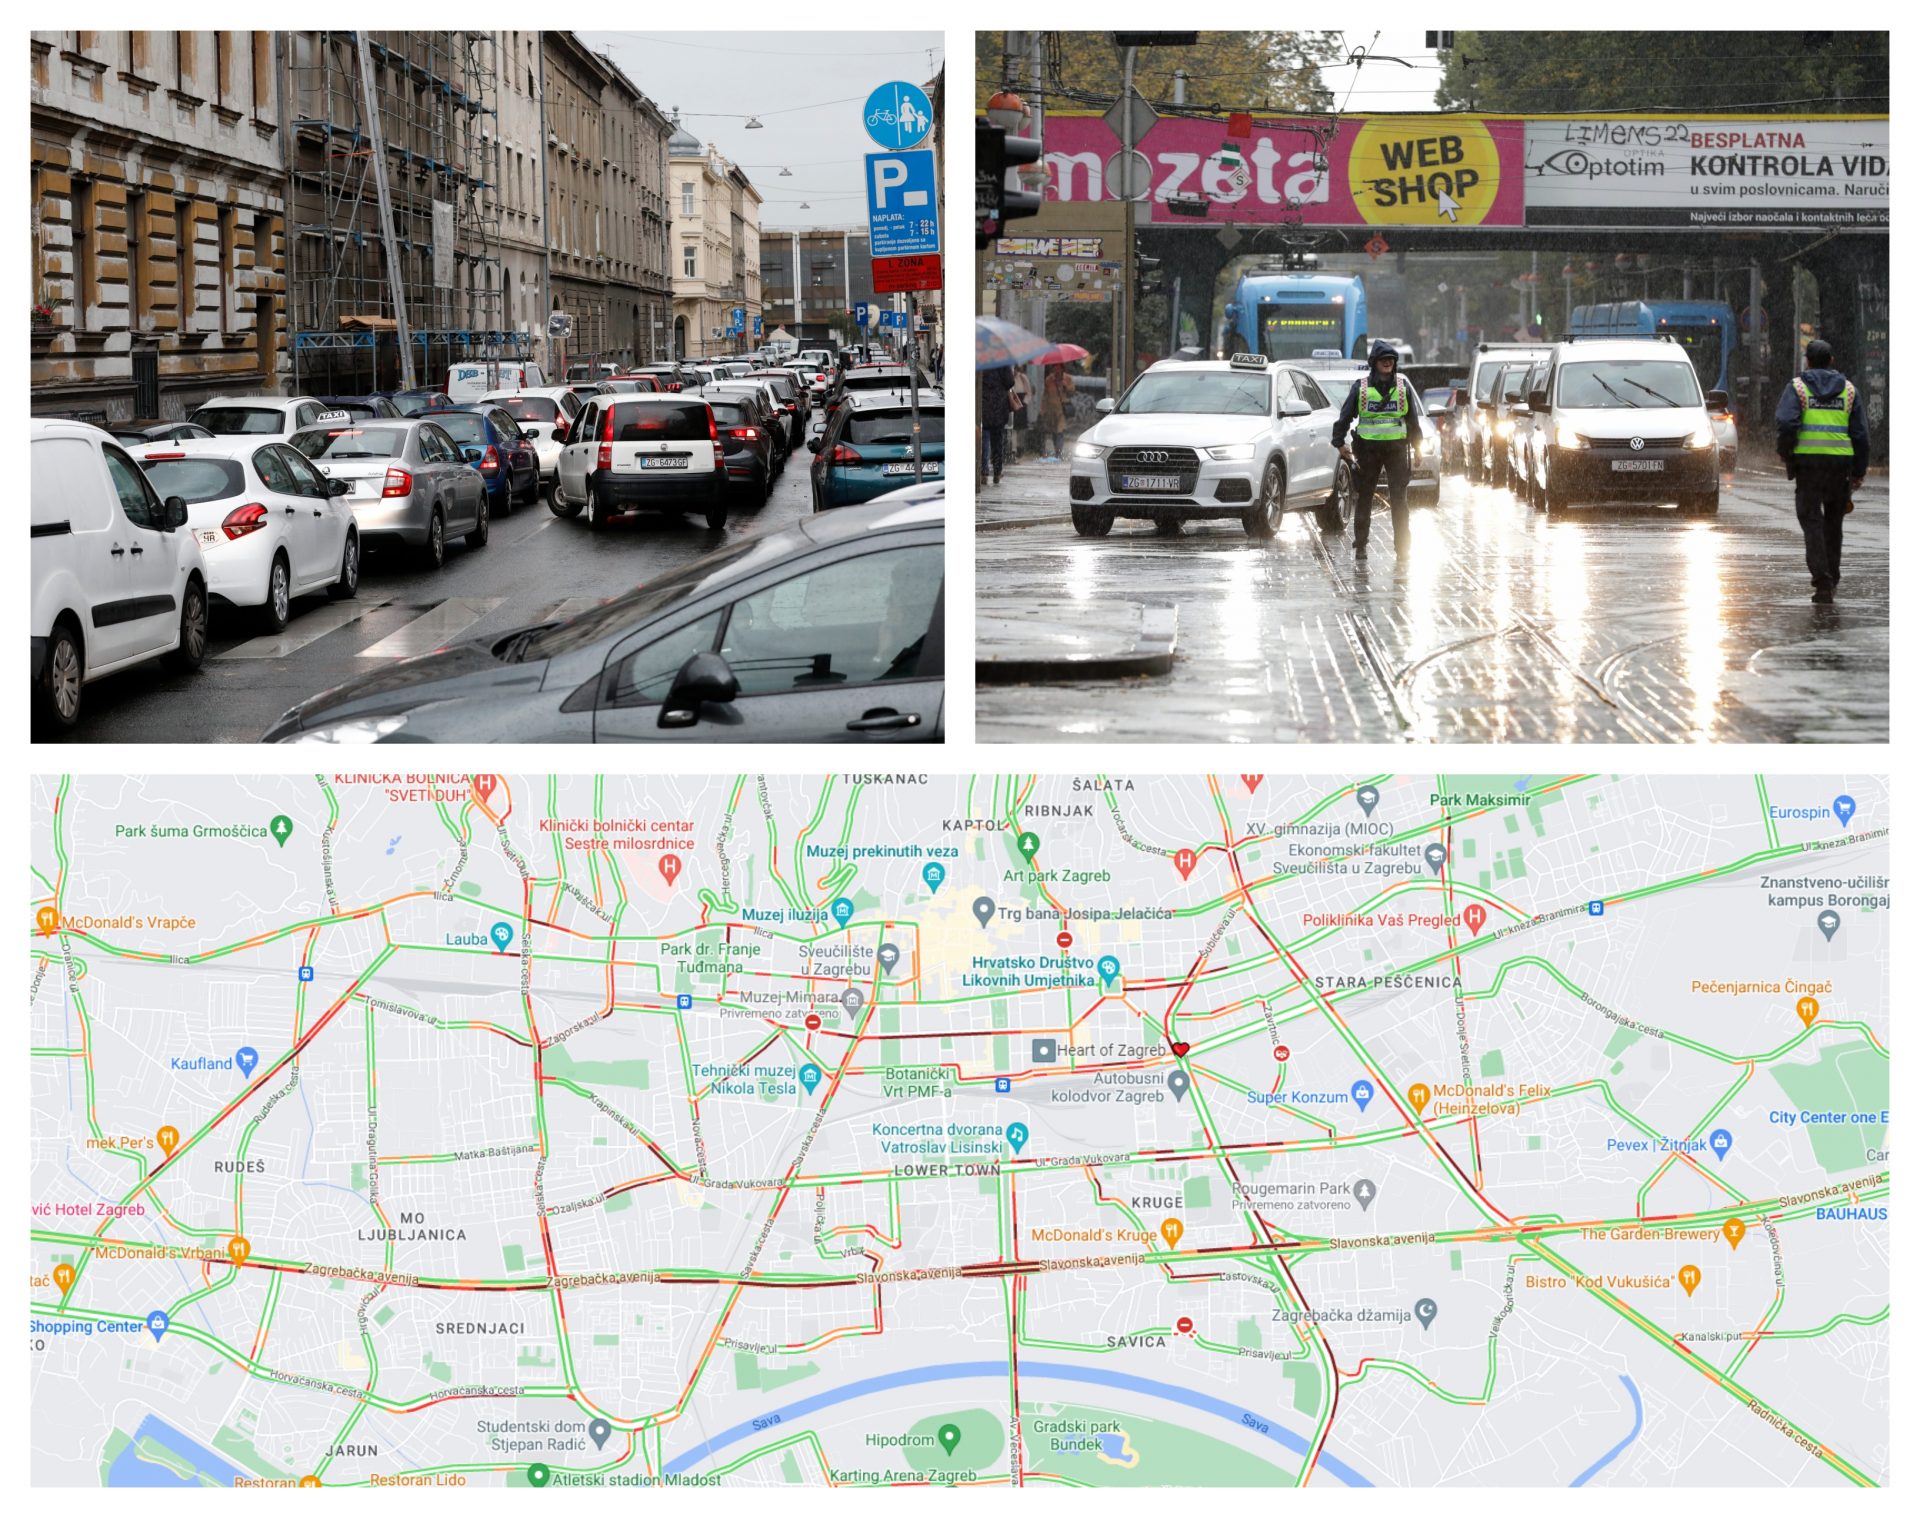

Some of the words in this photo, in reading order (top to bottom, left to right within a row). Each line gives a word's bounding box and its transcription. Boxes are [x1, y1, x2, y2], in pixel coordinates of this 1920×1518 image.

[1691, 133, 1805, 148] BESPLATNA
[1380, 134, 1464, 172] WEB
[1691, 156, 1833, 176] KONTROLA
[1374, 170, 1480, 209] SHOP
[1690, 186, 1698, 195] u
[1702, 184, 1735, 195] svim
[1740, 183, 1839, 199] poslovnicama.
[1844, 183, 1890, 195] Naruči
[873, 214, 904, 222] NAPLATA:
[1690, 212, 1725, 223] Najveći
[1728, 212, 1752, 222] izbor
[1754, 212, 1793, 222] naočala
[1801, 212, 1853, 222] kontaktnih
[898, 258, 924, 267] ZONA
[857, 306, 866, 321] P
[1234, 354, 1264, 365] TAXI
[322, 411, 344, 419] TAXI
[890, 463, 900, 472] ZG
[1128, 475, 1140, 489] ZG
[1073, 778, 1134, 791] ŠALATA
[1431, 794, 1460, 806] Park
[1465, 794, 1530, 806] Maksimir
[1025, 806, 1094, 817] RIBNJAK
[1770, 806, 1830, 823] Eurospin
[116, 824, 146, 838] Park
[150, 826, 189, 838] šuma
[194, 824, 268, 838] Grmoščica
[539, 820, 588, 832] Klinički
[593, 820, 646, 832] bolnički
[651, 821, 694, 832] centar
[943, 820, 1005, 832] KAPTOL
[565, 838, 609, 849] Sestre
[614, 838, 694, 849] milosrdnice
[807, 845, 849, 858] Muzej
[853, 845, 921, 858] prekinutih
[926, 848, 958, 857] veza
[1289, 845, 1365, 856] Ekonomski
[1370, 845, 1421, 856] fakultet
[1273, 861, 1348, 874] Sveučilišta
[1353, 865, 1359, 874] u
[1365, 862, 1421, 876] Zagrebu
[1004, 870, 1024, 881] Art
[1027, 870, 1059, 884] park
[1064, 870, 1110, 884] Zagreb
[742, 909, 783, 922] Muzej
[789, 909, 828, 922] iluzija
[998, 908, 1022, 922] Trg
[1027, 908, 1059, 920] bana
[1064, 908, 1111, 922] Josipa
[1115, 907, 1172, 920] Jelačića
[62, 916, 143, 929] McDonald's
[148, 916, 195, 932] Vrapče
[1304, 914, 1373, 926] Poliklinika
[1378, 914, 1404, 926] Vaš
[1409, 914, 1461, 929] Pregled
[446, 933, 487, 946] Lauba
[170, 955, 189, 964] Ilica
[973, 957, 1034, 968] Hrvatsko
[1039, 956, 1094, 968] Društvo
[963, 975, 1019, 986] Likovnih
[1024, 975, 1095, 990] Umjetnika
[1316, 976, 1366, 988] STARA
[1373, 974, 1462, 988] PEŠČENICA
[1692, 981, 1780, 996] Pečenjarnica
[1785, 978, 1832, 996] Čingač
[1058, 1045, 1096, 1056] Heart
[1100, 1045, 1112, 1056] of
[1116, 1045, 1166, 1059] Zagreb
[171, 1058, 232, 1070] Kaufland
[693, 1065, 749, 1077] Tehnički
[754, 1066, 796, 1079] muzej
[712, 1082, 758, 1094] Nikola
[762, 1082, 796, 1094] Tesla
[1434, 1084, 1514, 1097] McDonald's
[1519, 1084, 1550, 1097] Felix
[1248, 1092, 1286, 1106] Super
[1292, 1092, 1348, 1103] Konzum
[1433, 1102, 1520, 1116] (Heinzelova)
[873, 1123, 943, 1136] Koncertna
[947, 1123, 1002, 1136] dvorana
[882, 1142, 946, 1153] Vatroslav
[951, 1142, 1002, 1153] Lisinski
[215, 1158, 265, 1173] RUDEŠ
[895, 1165, 949, 1175] LOWER
[956, 1165, 1001, 1175] TOWN
[1132, 1197, 1182, 1208] KRUGE
[1816, 1208, 1887, 1220] BAUHAUS
[1330, 1238, 1389, 1249] Slavonska
[1391, 1233, 1435, 1245] avenija
[1580, 1228, 1606, 1240] The
[1611, 1228, 1660, 1240] Garden
[1665, 1228, 1720, 1242] Brewery
[547, 1274, 617, 1288] Zagrebačka
[620, 1273, 660, 1285] avenija
[1526, 1276, 1565, 1288] Bistro
[1570, 1275, 1602, 1288] "Kod
[1607, 1275, 1675, 1288] Vukušića"
[1273, 1310, 1352, 1322] Zagrebačka
[1357, 1309, 1411, 1324] džamija
[436, 1323, 524, 1334] SREDNJACI
[1107, 1336, 1165, 1347] SAVICA
[477, 1421, 550, 1433] Studentski
[555, 1421, 585, 1433] dom
[753, 1414, 781, 1430] Sava
[1034, 1421, 1086, 1433] Gradski
[1091, 1422, 1120, 1436] park
[492, 1439, 543, 1454] Stjepan
[548, 1439, 585, 1451] Radić
[867, 1434, 934, 1449] Hipodrom
[1050, 1439, 1102, 1451] Bundek
[325, 1445, 378, 1457] JARUN
